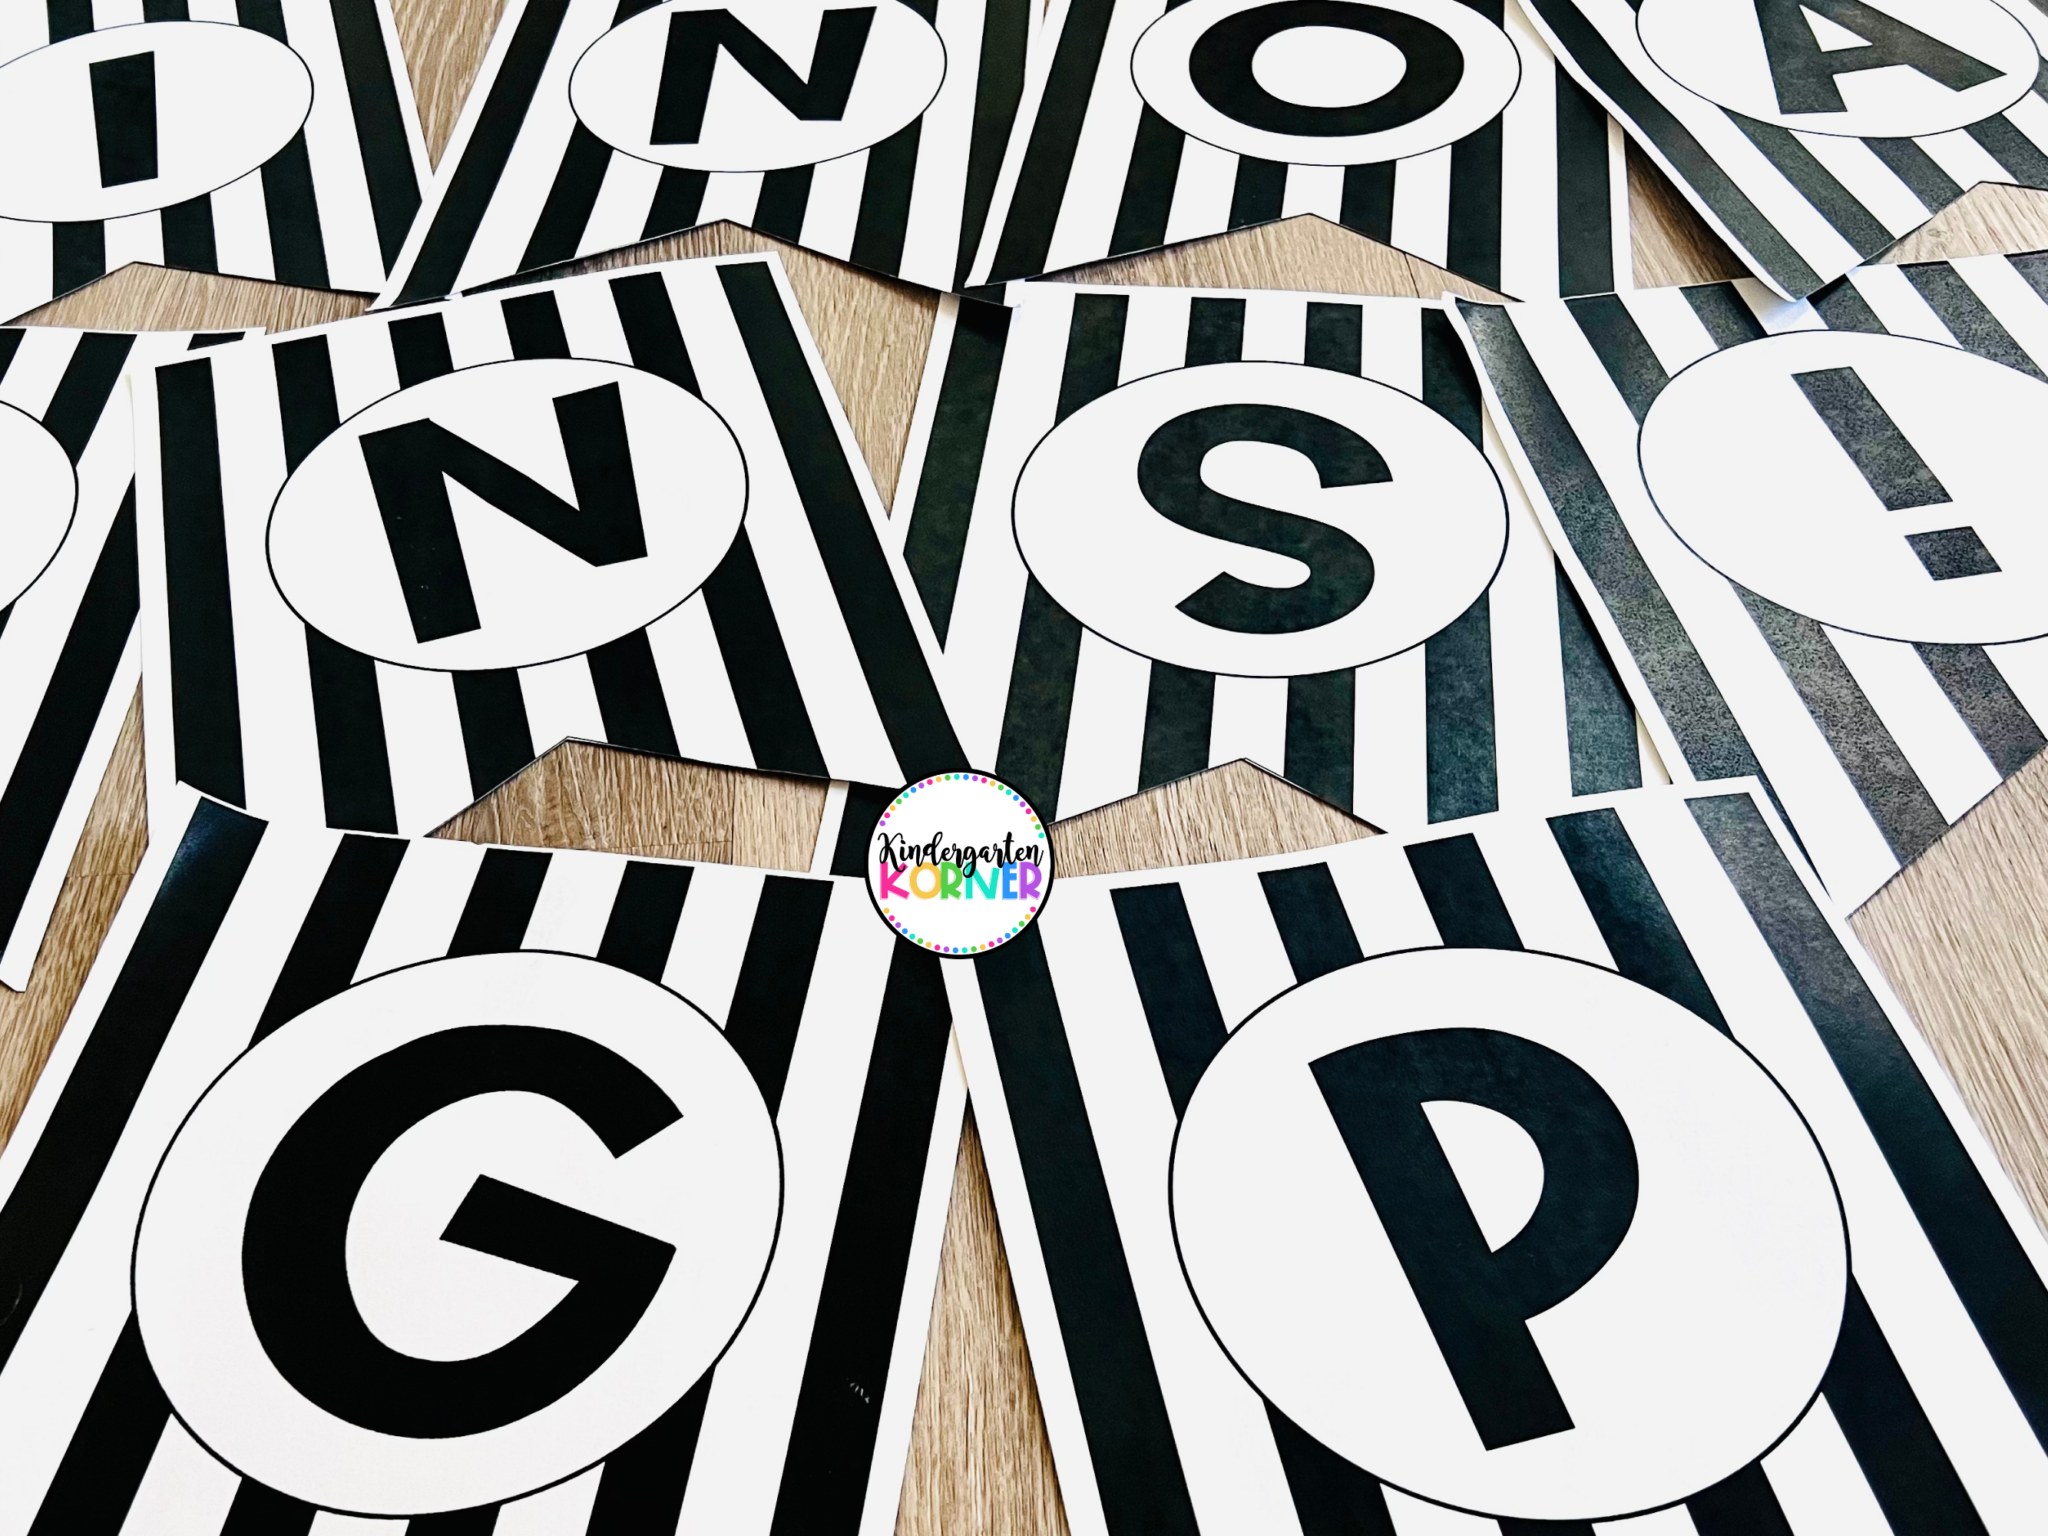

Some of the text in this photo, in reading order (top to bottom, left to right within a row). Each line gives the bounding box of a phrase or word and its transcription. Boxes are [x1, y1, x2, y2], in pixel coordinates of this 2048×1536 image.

[650, 6, 877, 145] N
[1189, 0, 1464, 137] O
[1754, 0, 2006, 114] A
[359, 381, 648, 643] N
[1137, 404, 1393, 634] S
[242, 1025, 683, 1439] G
[1308, 1028, 1639, 1451] P
